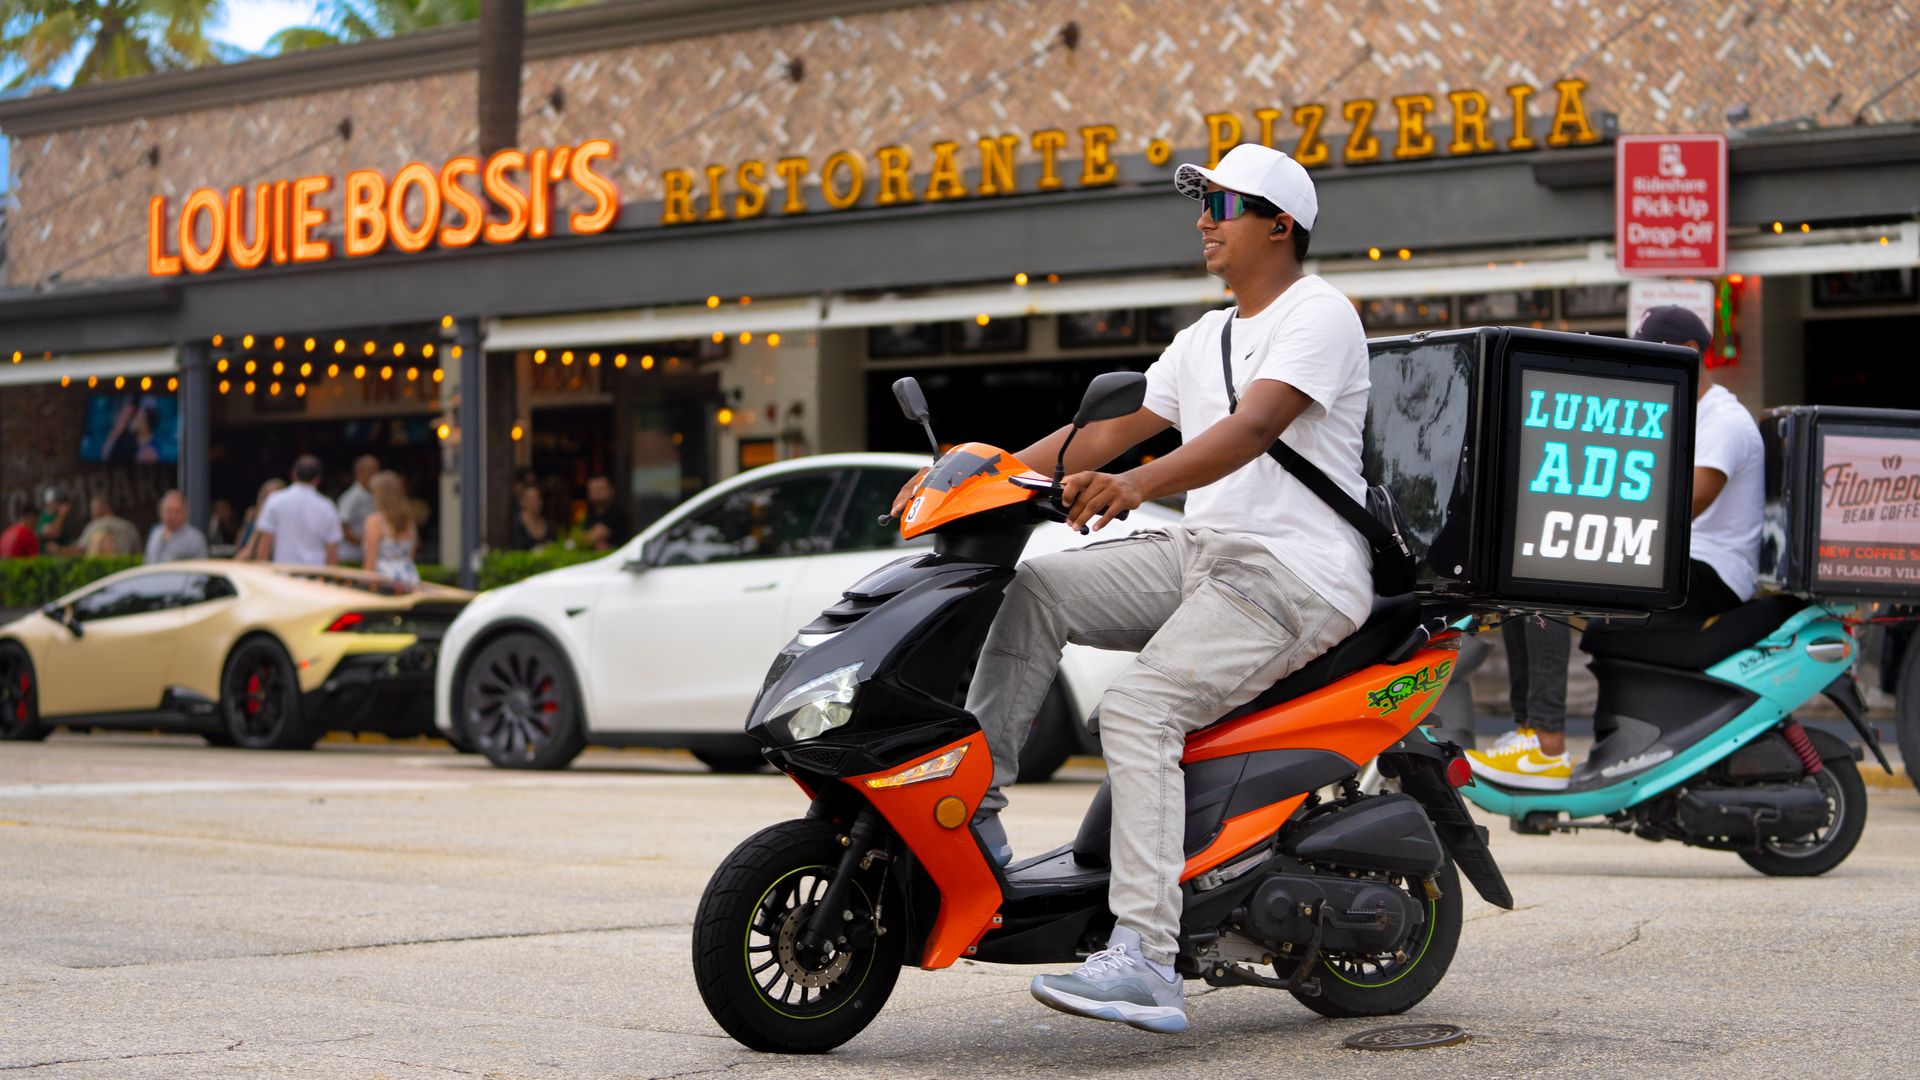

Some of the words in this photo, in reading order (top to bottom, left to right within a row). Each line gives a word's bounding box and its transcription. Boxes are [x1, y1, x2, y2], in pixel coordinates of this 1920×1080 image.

[148, 176, 331, 275] LOUIE
[345, 139, 617, 257] BOSSI'S
[661, 125, 1118, 224] RISTORANTE
[1205, 80, 1599, 168] PIZZERIA
[1633, 176, 1707, 193] Rideshare
[1632, 196, 1709, 222] Pick-Up
[1628, 222, 1713, 247] Drop-Off
[1524, 389, 1669, 439] LUMIX
[1530, 441, 1655, 501] ADS
[907, 498, 921, 520] 3
[1842, 507, 1875, 524] BEAN
[1522, 510, 1659, 565] .COM
[1819, 545, 1850, 559] NEW
[1855, 547, 1905, 560] COFFEE
[1818, 563, 1833, 576] IN
[1837, 565, 1892, 578] FLAGLER
